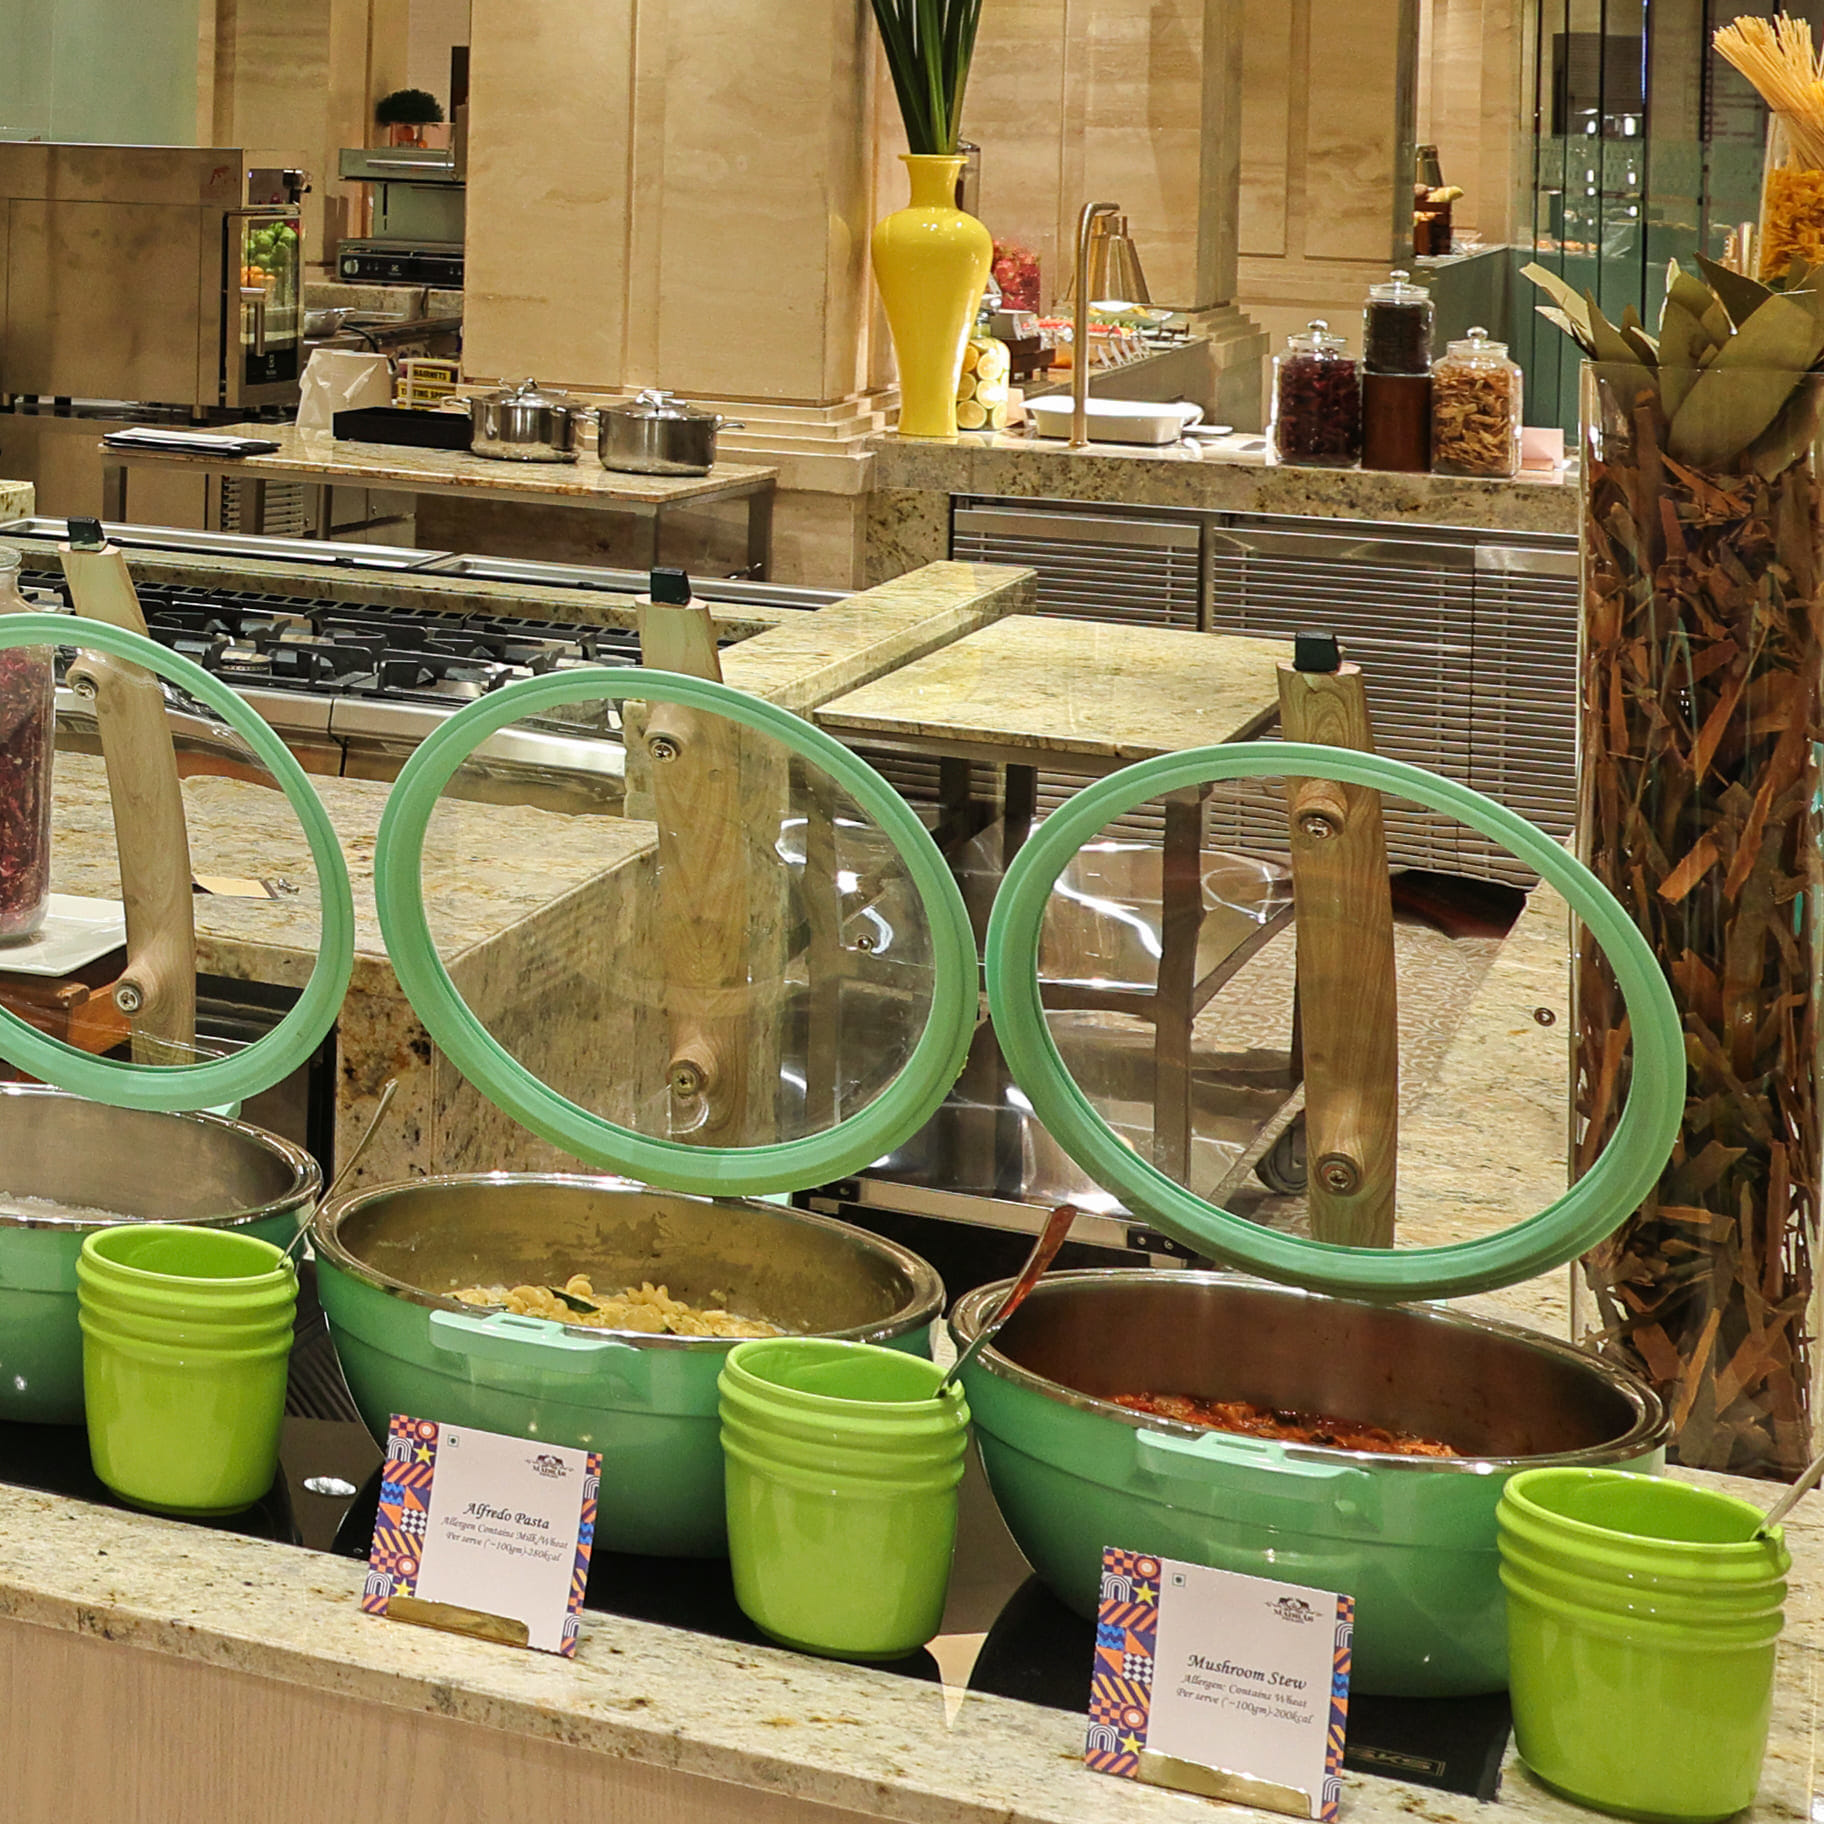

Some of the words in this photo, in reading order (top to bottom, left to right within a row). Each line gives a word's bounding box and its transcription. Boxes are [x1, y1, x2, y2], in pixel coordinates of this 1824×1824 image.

[440, 1516, 476, 1531] Allergen
[477, 1523, 515, 1538] Contains
[462, 1502, 512, 1522] Alfredo
[514, 1512, 550, 1530] Pasta
[446, 1531, 461, 1541] Per
[461, 1536, 483, 1546] serve
[1187, 1654, 1265, 1682] Mushroom
[1267, 1671, 1307, 1690] Stew
[1176, 1687, 1194, 1697] Per
[1195, 1693, 1220, 1704] serve
[1228, 1684, 1272, 1701] Contains
[1275, 1693, 1307, 1708] Wheat
